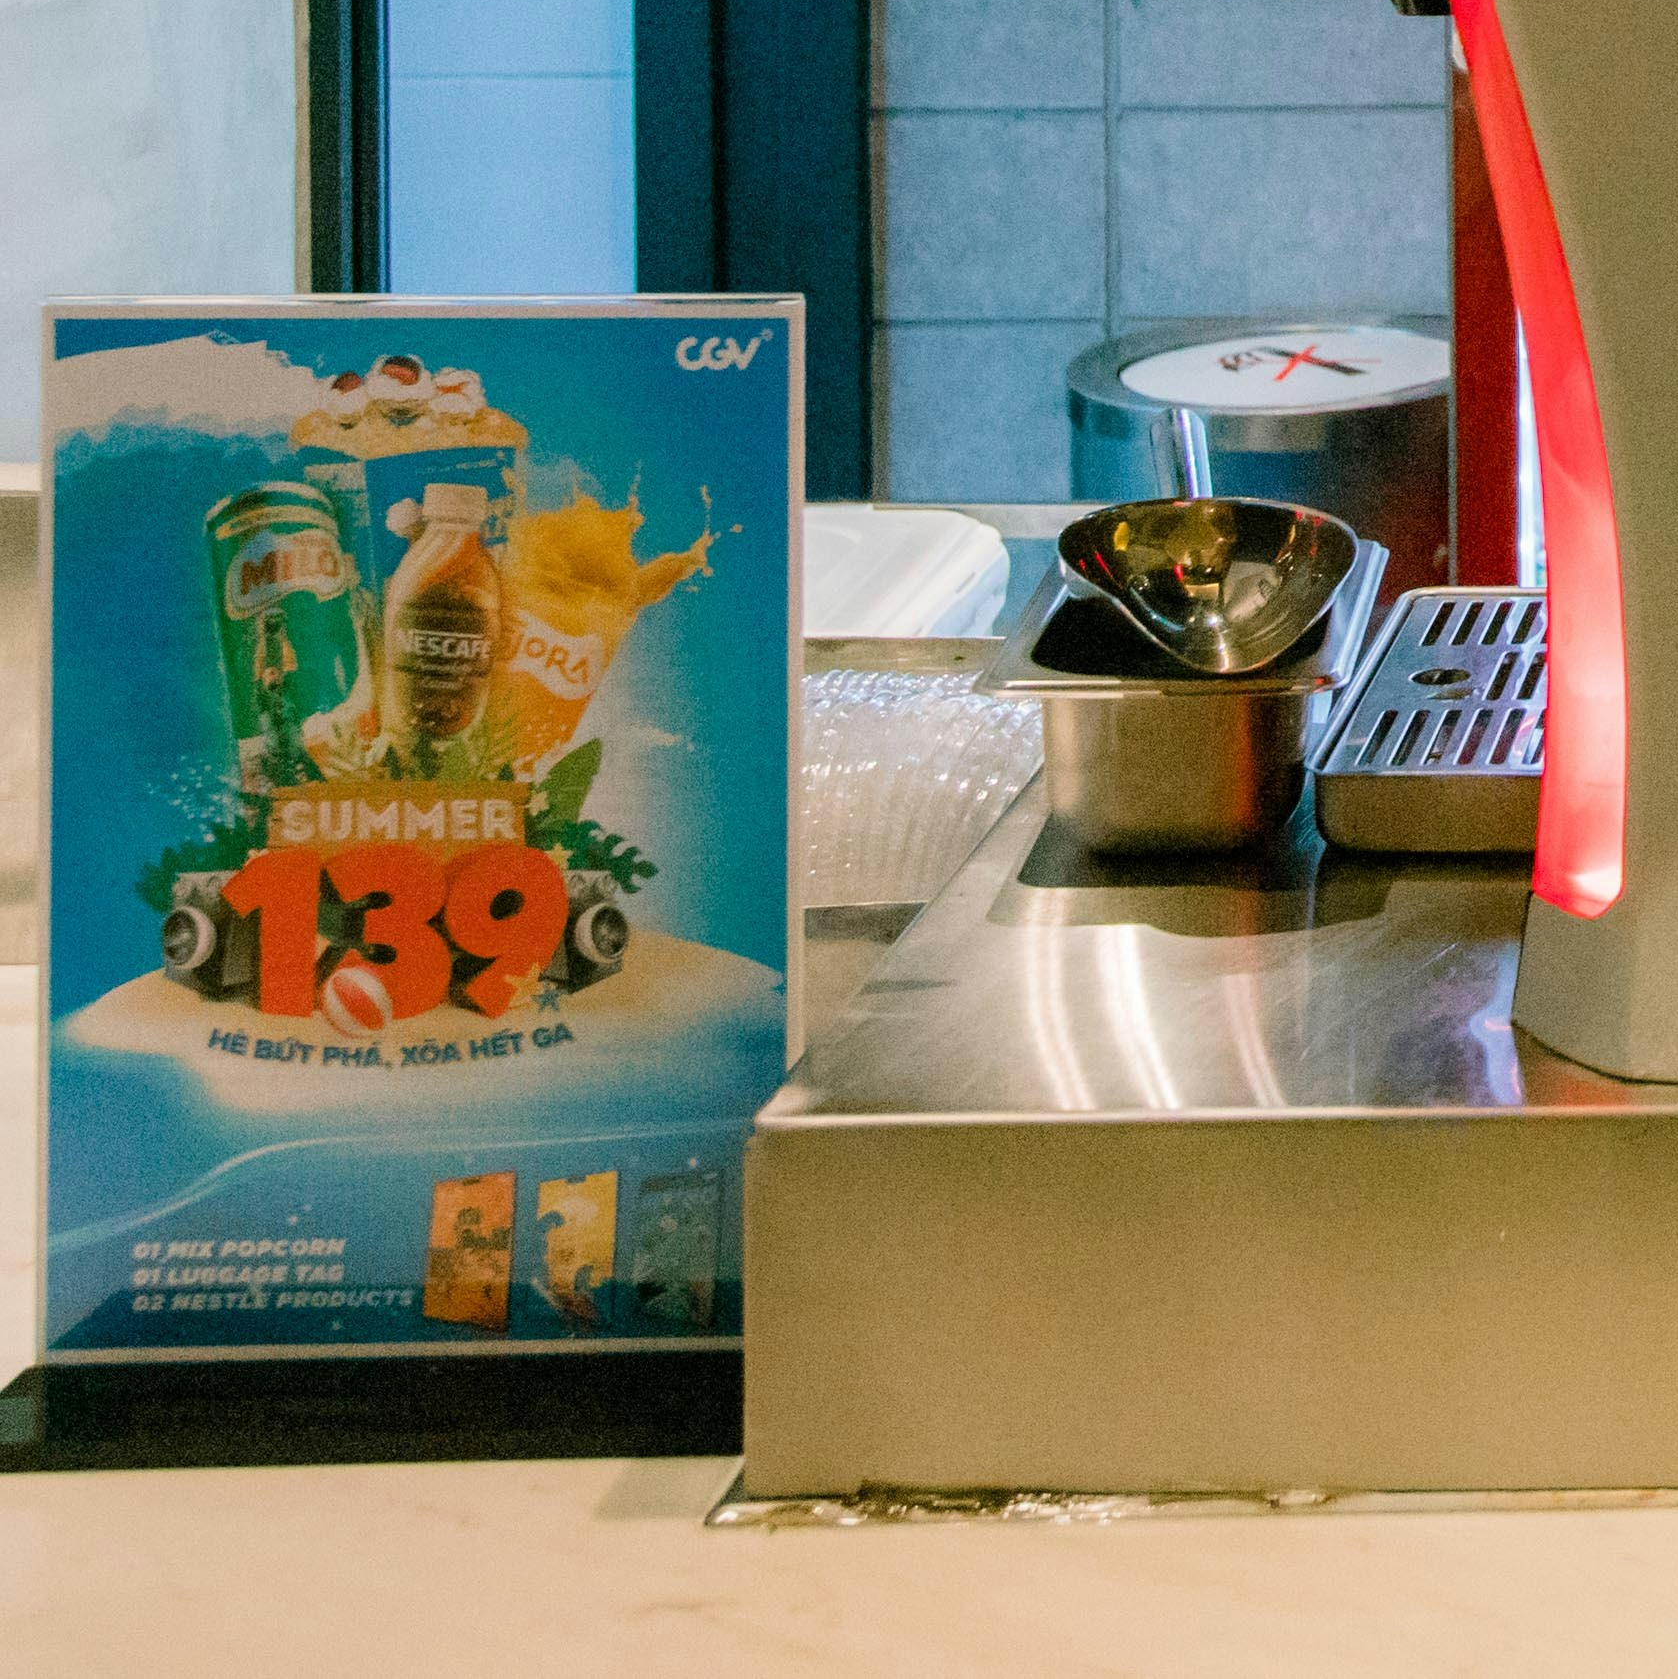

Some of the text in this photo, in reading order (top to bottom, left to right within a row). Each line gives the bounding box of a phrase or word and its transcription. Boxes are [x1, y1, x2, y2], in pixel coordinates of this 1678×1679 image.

[675, 335, 761, 372] CGV
[280, 798, 518, 843] SUMMER
[221, 843, 570, 1020] 139
[532, 1022, 574, 1049] GA
[132, 1237, 347, 1260] 01 MIX POPCORN
[132, 1262, 345, 1286] 01 LUGGAGE TAG
[132, 1293, 166, 1311] 02
